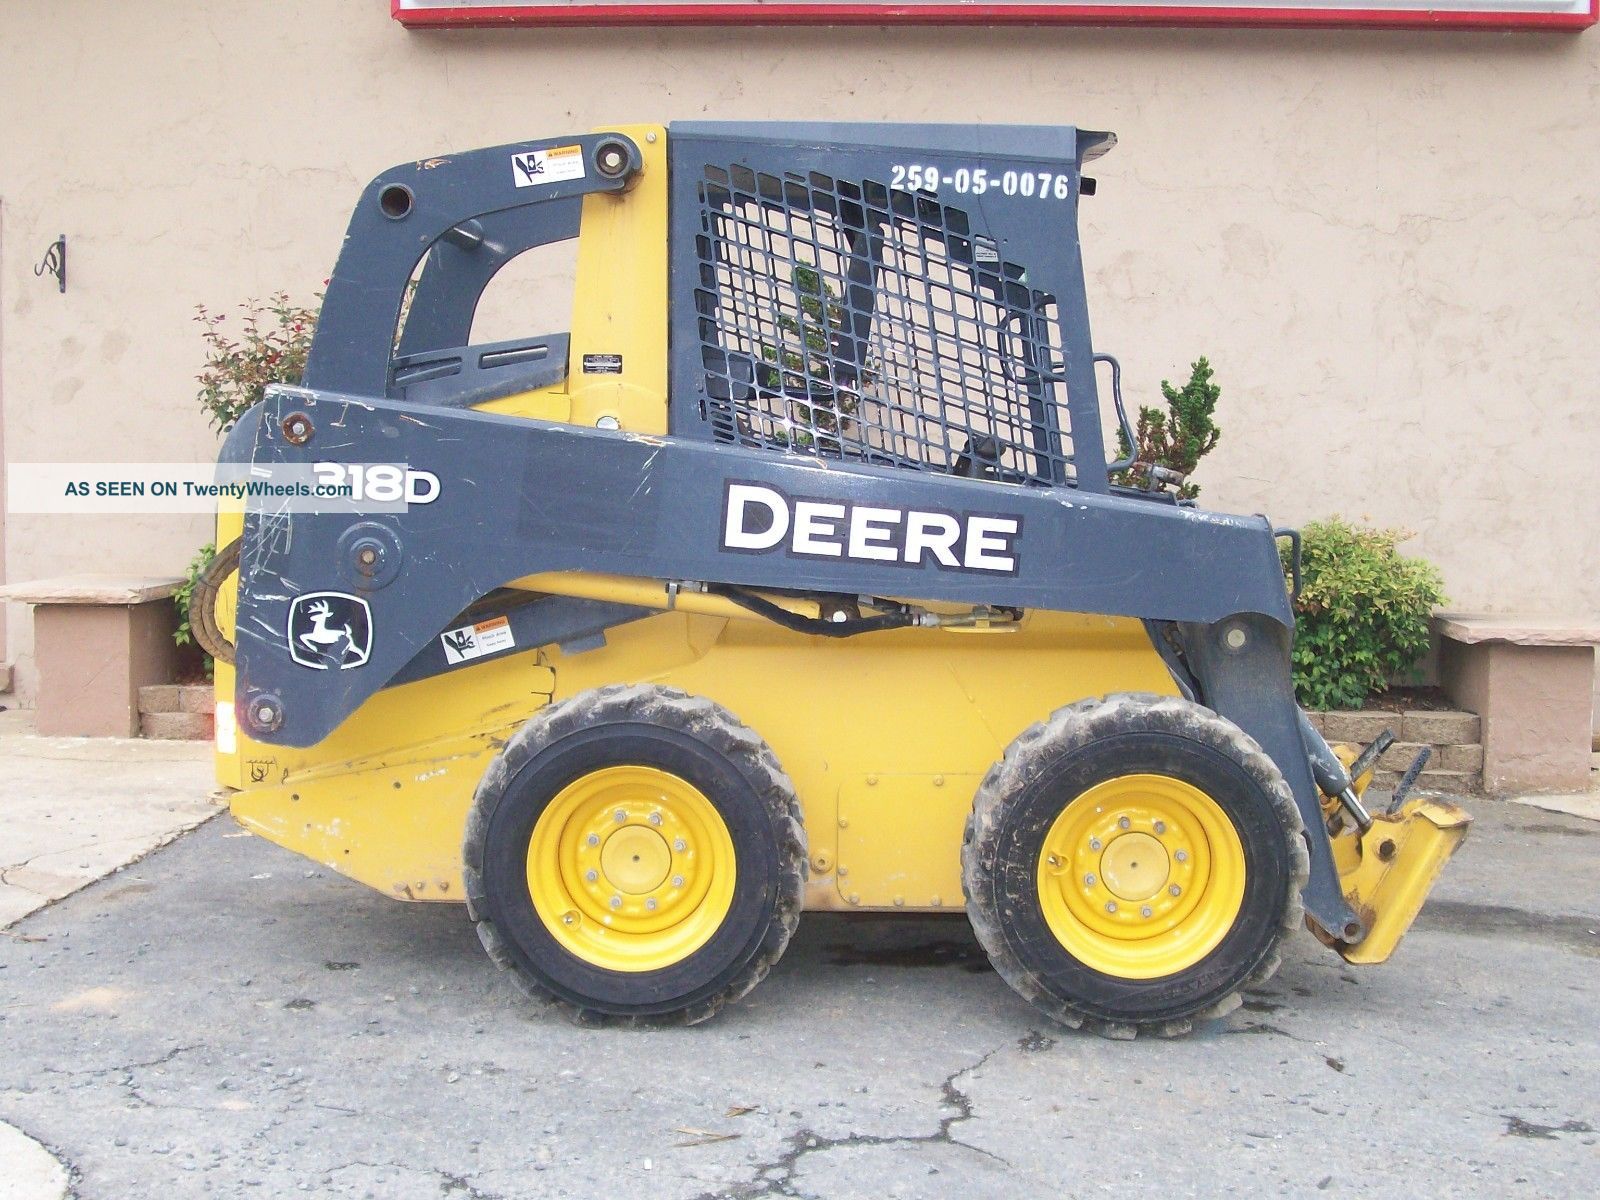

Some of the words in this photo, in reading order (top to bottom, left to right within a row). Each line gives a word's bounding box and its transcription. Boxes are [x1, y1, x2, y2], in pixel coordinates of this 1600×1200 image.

[890, 165, 1069, 200] 259-05-0076
[313, 461, 441, 504] 318D
[725, 484, 1018, 571] DEERE
